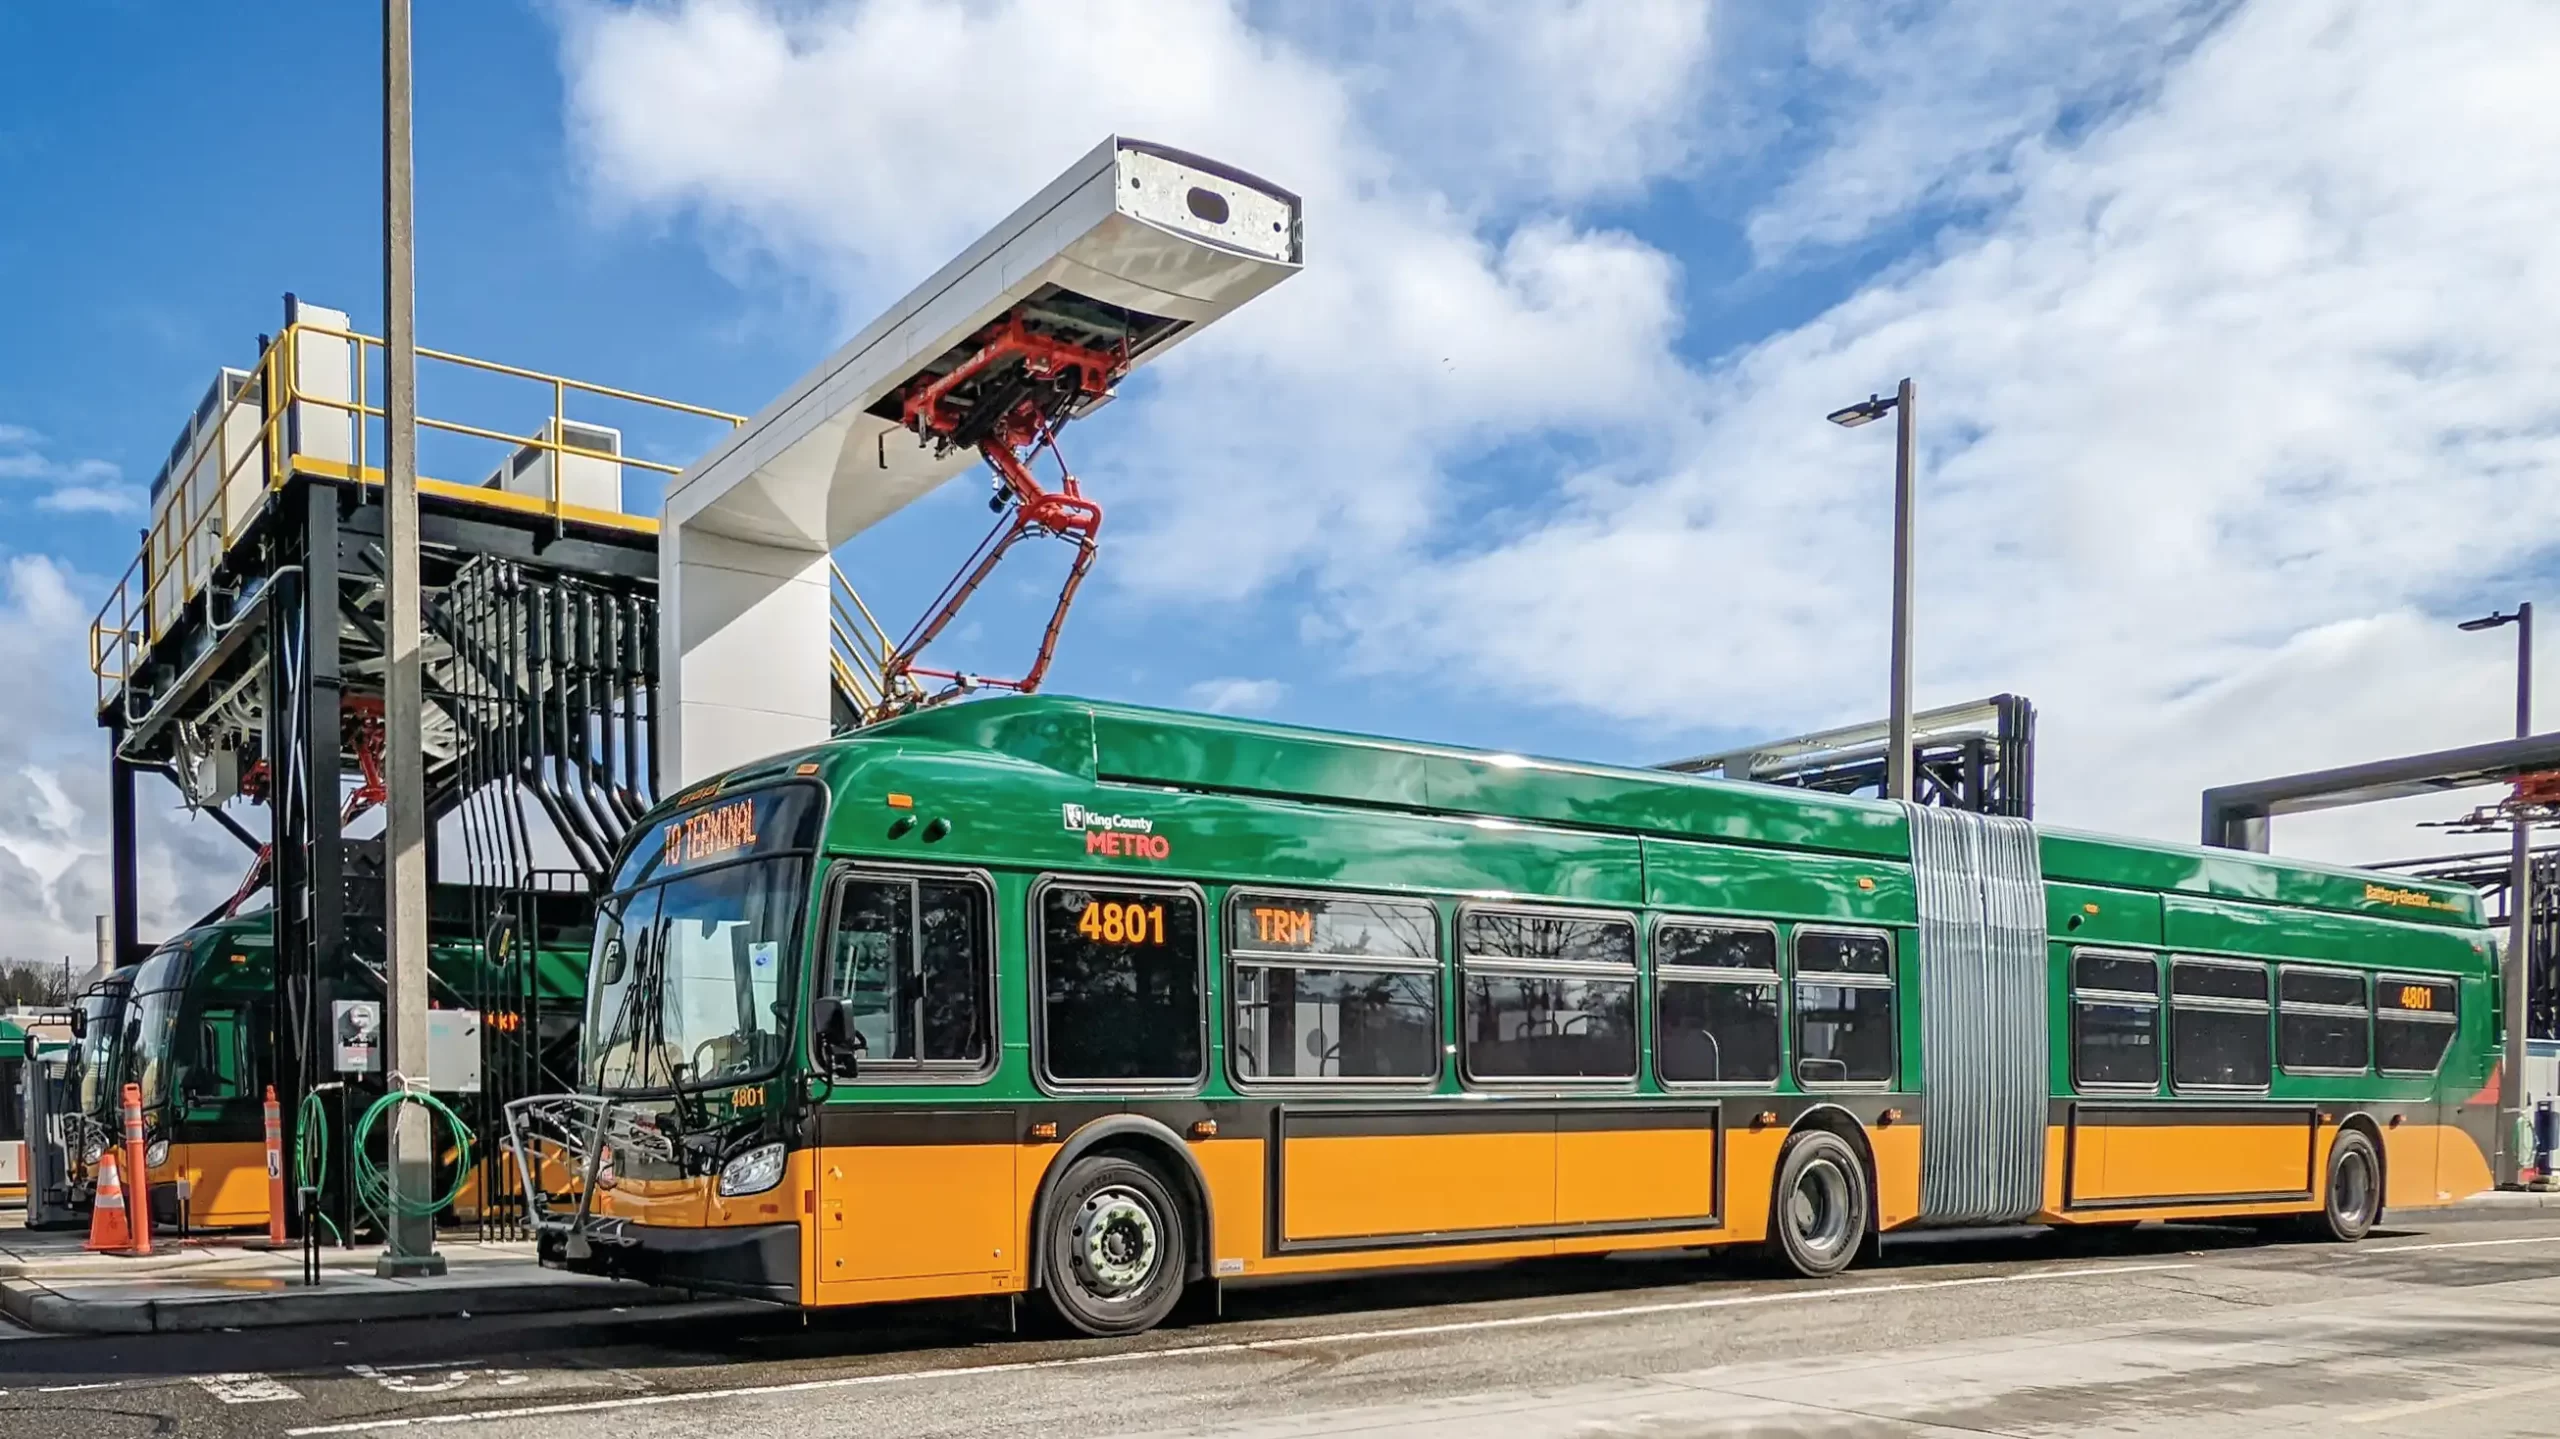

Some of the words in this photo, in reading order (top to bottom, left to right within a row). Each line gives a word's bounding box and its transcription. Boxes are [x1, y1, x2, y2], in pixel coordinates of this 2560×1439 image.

[664, 823, 681, 867] TO
[685, 798, 757, 861] TERMINAL
[1085, 811, 1112, 830] King
[1112, 813, 1153, 833] County
[1086, 830, 1170, 859] METRO
[1079, 902, 1164, 944] 4801
[1255, 907, 1312, 944] TRM
[2401, 985, 2431, 1009] 4801
[731, 1086, 765, 1107] 4801
